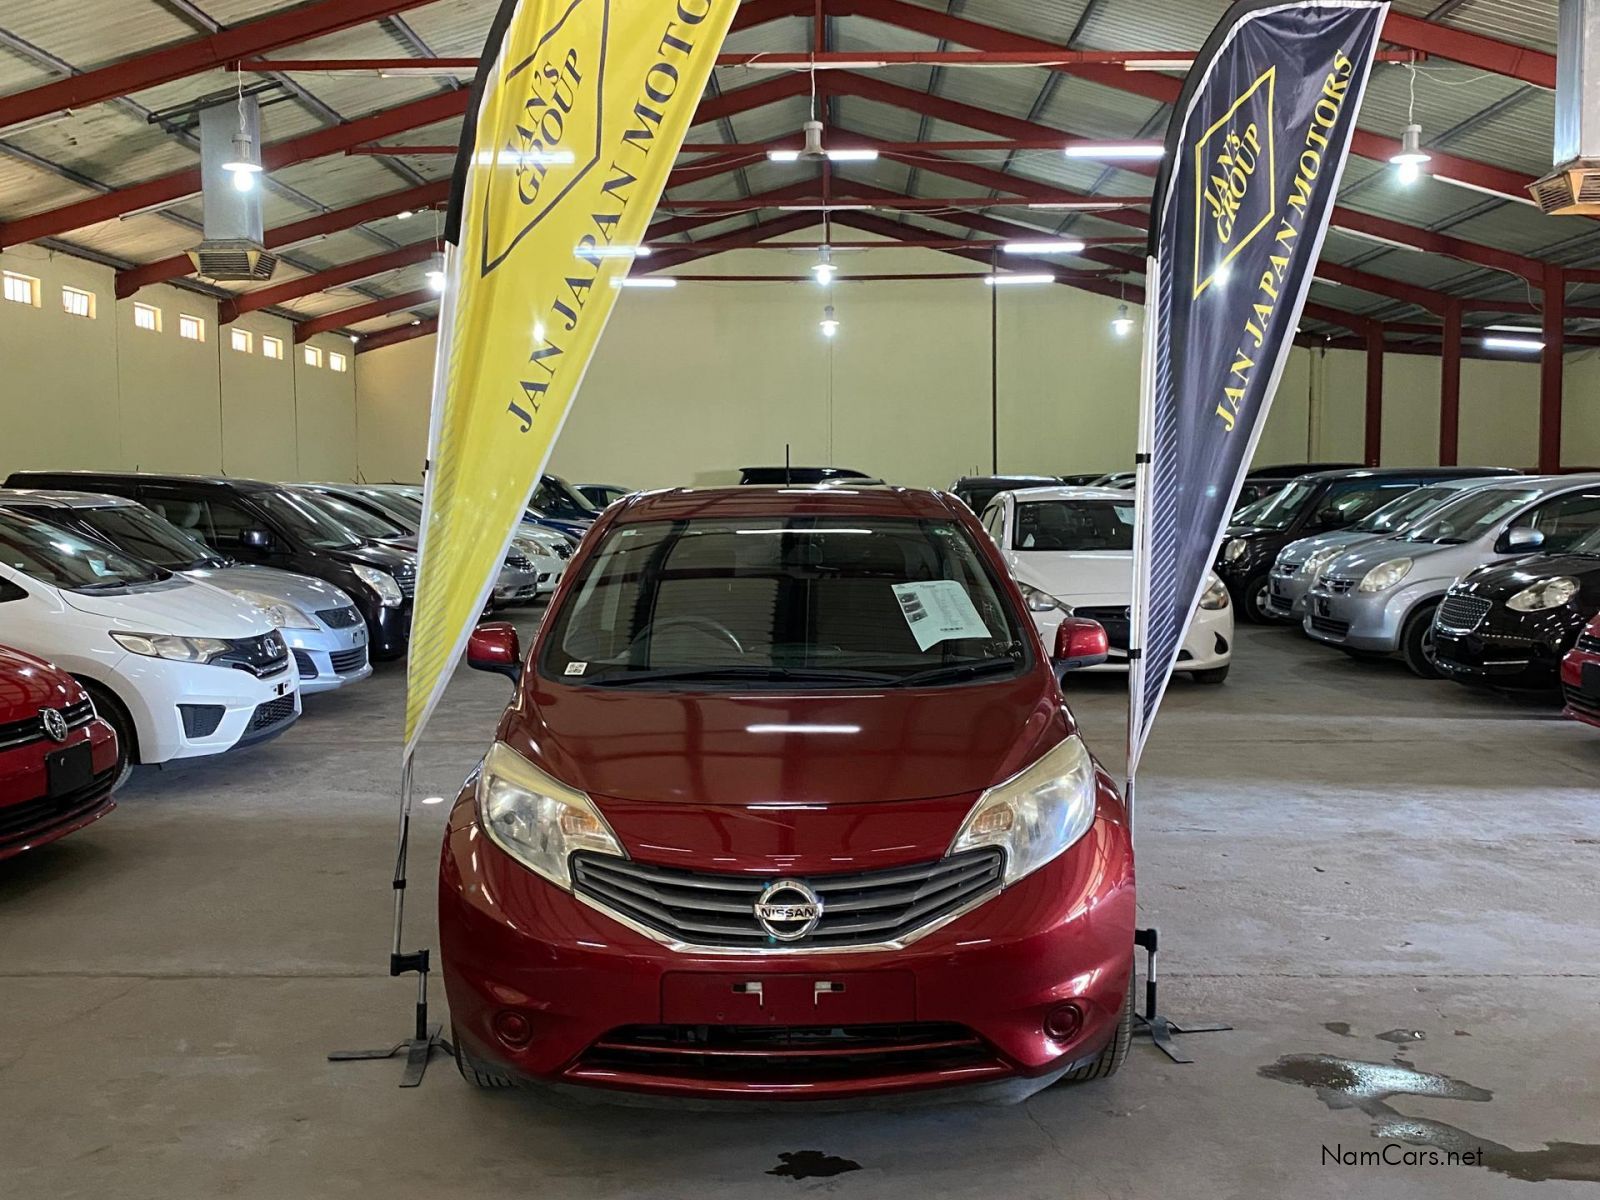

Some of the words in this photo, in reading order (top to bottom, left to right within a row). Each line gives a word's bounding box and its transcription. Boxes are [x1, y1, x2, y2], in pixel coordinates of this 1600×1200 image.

[518, 48, 582, 205] GROUP
[1217, 123, 1261, 243] GROUP
[506, 338, 564, 432] JAN
[551, 160, 637, 331] JAPAN
[1215, 348, 1255, 432] JAN
[1245, 217, 1299, 347] JAPAN
[1287, 49, 1353, 219] MOTORS
[761, 907, 815, 918] NISSAN
